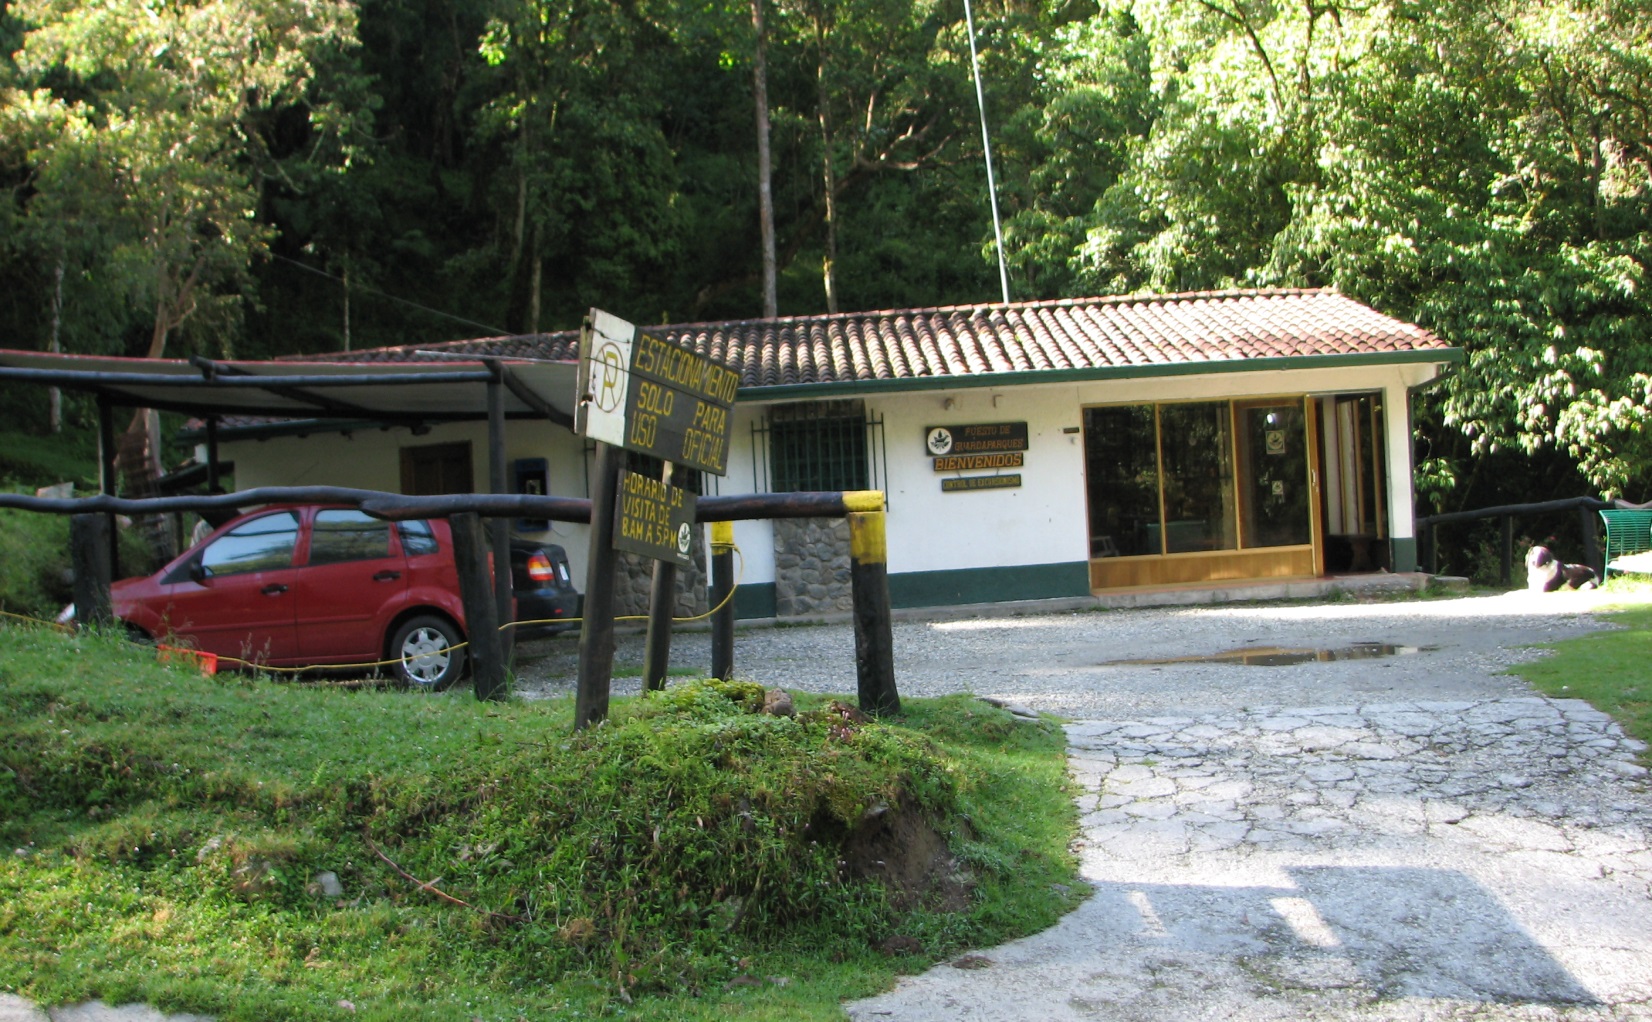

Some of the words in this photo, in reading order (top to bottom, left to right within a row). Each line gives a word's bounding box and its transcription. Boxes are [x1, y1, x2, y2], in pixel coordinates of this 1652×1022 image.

[635, 334, 739, 403] ESTACIONAMIENTO
[637, 381, 674, 416] SOLO
[693, 401, 727, 436] PARA
[630, 410, 657, 448] USO
[682, 428, 724, 470] OFICIAL
[954, 438, 1024, 451] GUARDAPARQUES
[964, 425, 997, 437] PUESTO
[1000, 424, 1011, 434] DE
[934, 453, 1022, 470] BIENVENIDOS
[623, 471, 667, 502] HORARIO
[671, 486, 684, 508] DE
[623, 494, 656, 522] VISITA
[658, 504, 671, 526] DE
[645, 523, 653, 544] A
